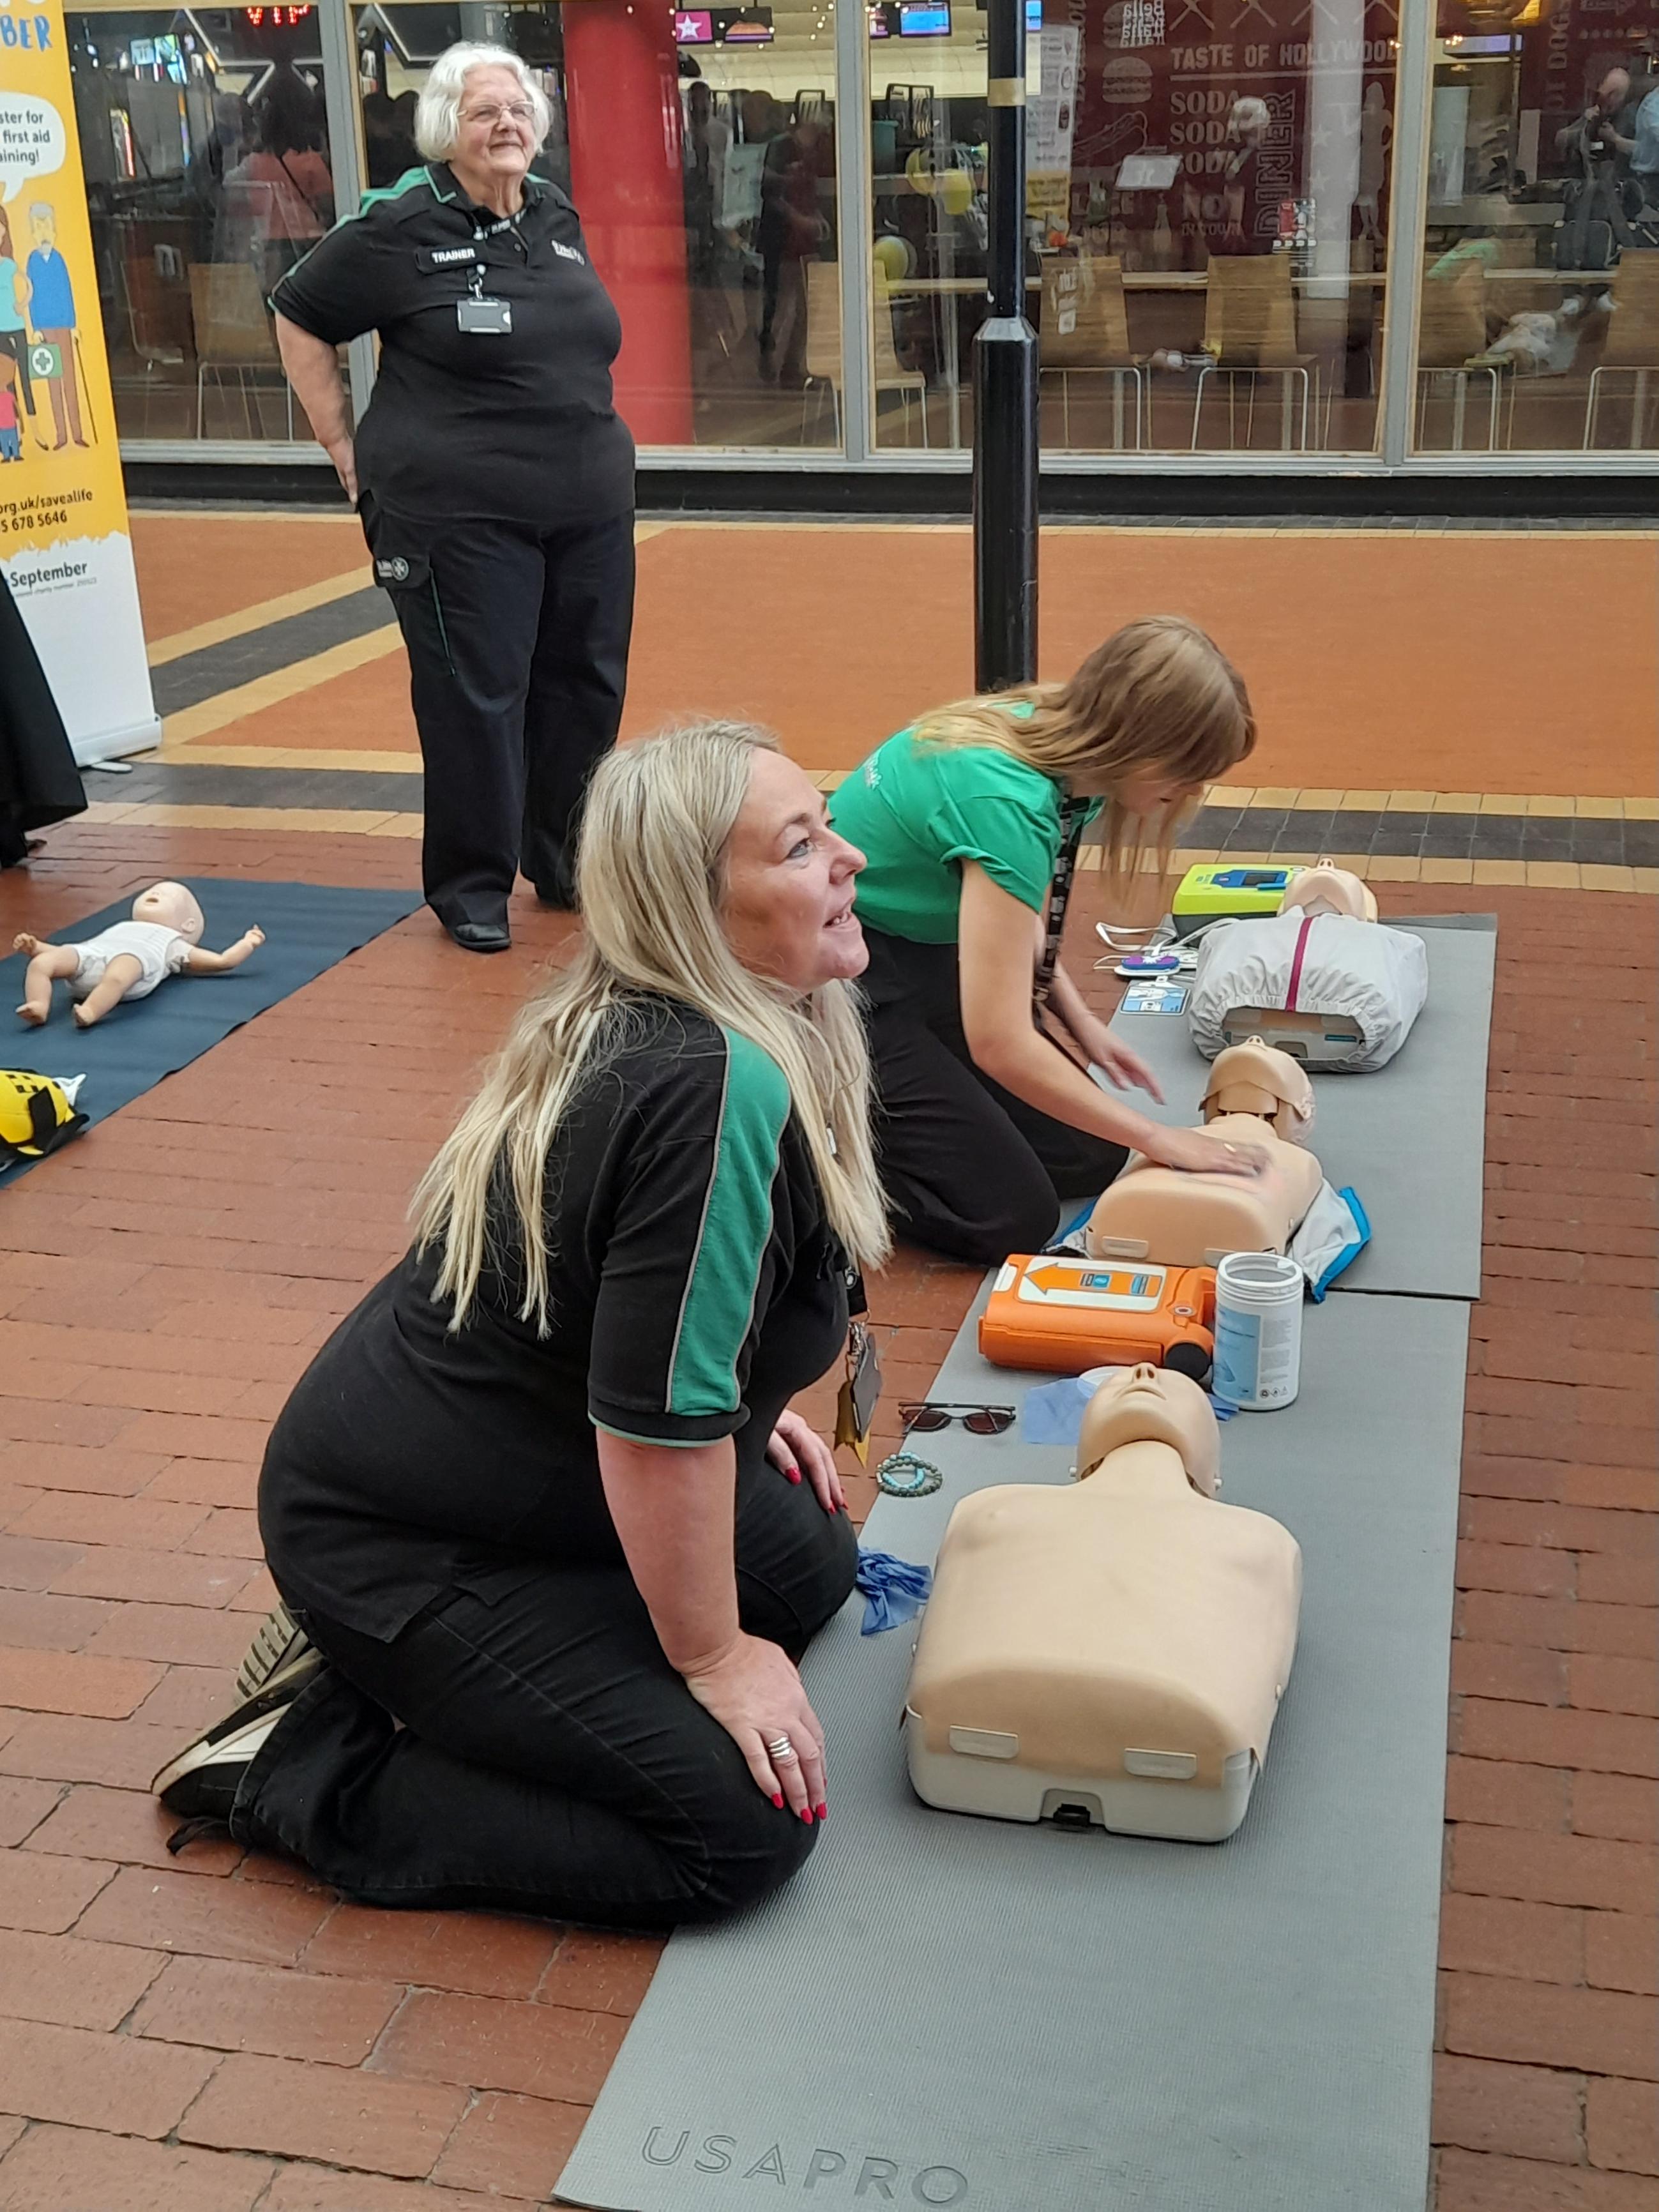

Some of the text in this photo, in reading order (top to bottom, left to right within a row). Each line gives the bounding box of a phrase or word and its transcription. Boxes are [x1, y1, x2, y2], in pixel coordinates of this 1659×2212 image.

[1170, 43, 1234, 70] TASTE
[1245, 43, 1270, 68] OF
[1169, 89, 1241, 115] SODA
[26, 109, 43, 124] for
[3, 129, 50, 144] first aid
[1169, 120, 1241, 145] SODA
[1177, 150, 1240, 175] ODA
[1254, 89, 1295, 238] DINER
[432, 247, 475, 264] TRAINER
[11, 515, 34, 531] 678
[37, 510, 68, 528] 5646
[10, 561, 87, 591] September
[642, 2126, 969, 2208] USAPRO
